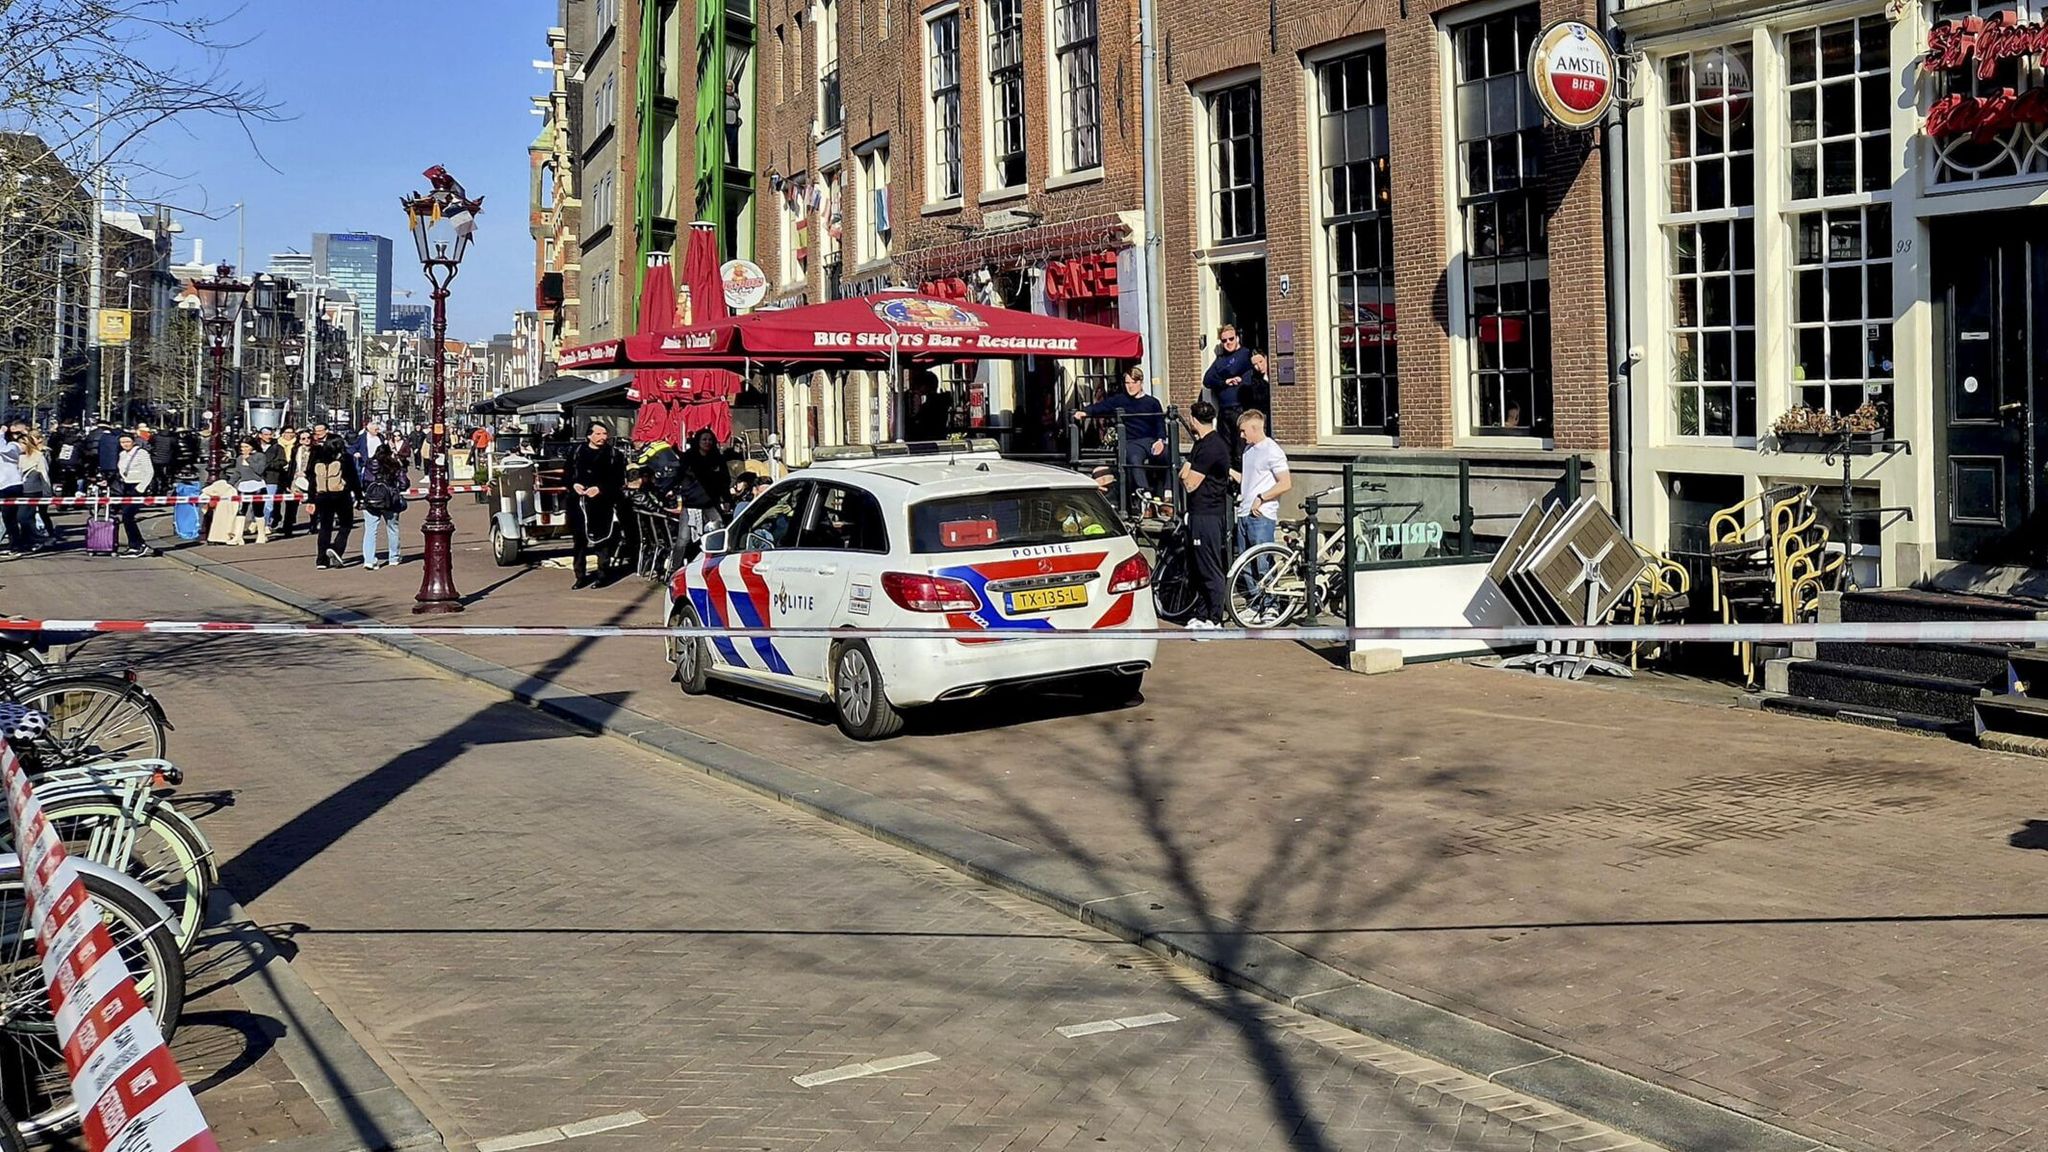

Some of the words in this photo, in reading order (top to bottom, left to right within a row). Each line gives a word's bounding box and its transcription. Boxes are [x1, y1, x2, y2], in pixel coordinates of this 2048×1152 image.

[1555, 56, 1606, 77] AMSTEL
[1571, 77, 1596, 92] BIER
[1896, 239, 1913, 254] 93
[813, 331, 852, 346] BIG
[855, 332, 924, 347] SHOTS
[927, 333, 962, 348] Bar
[976, 334, 1079, 351] Restaurant
[1011, 544, 1073, 558] POLITIE
[1019, 588, 1079, 608] TX-135-L
